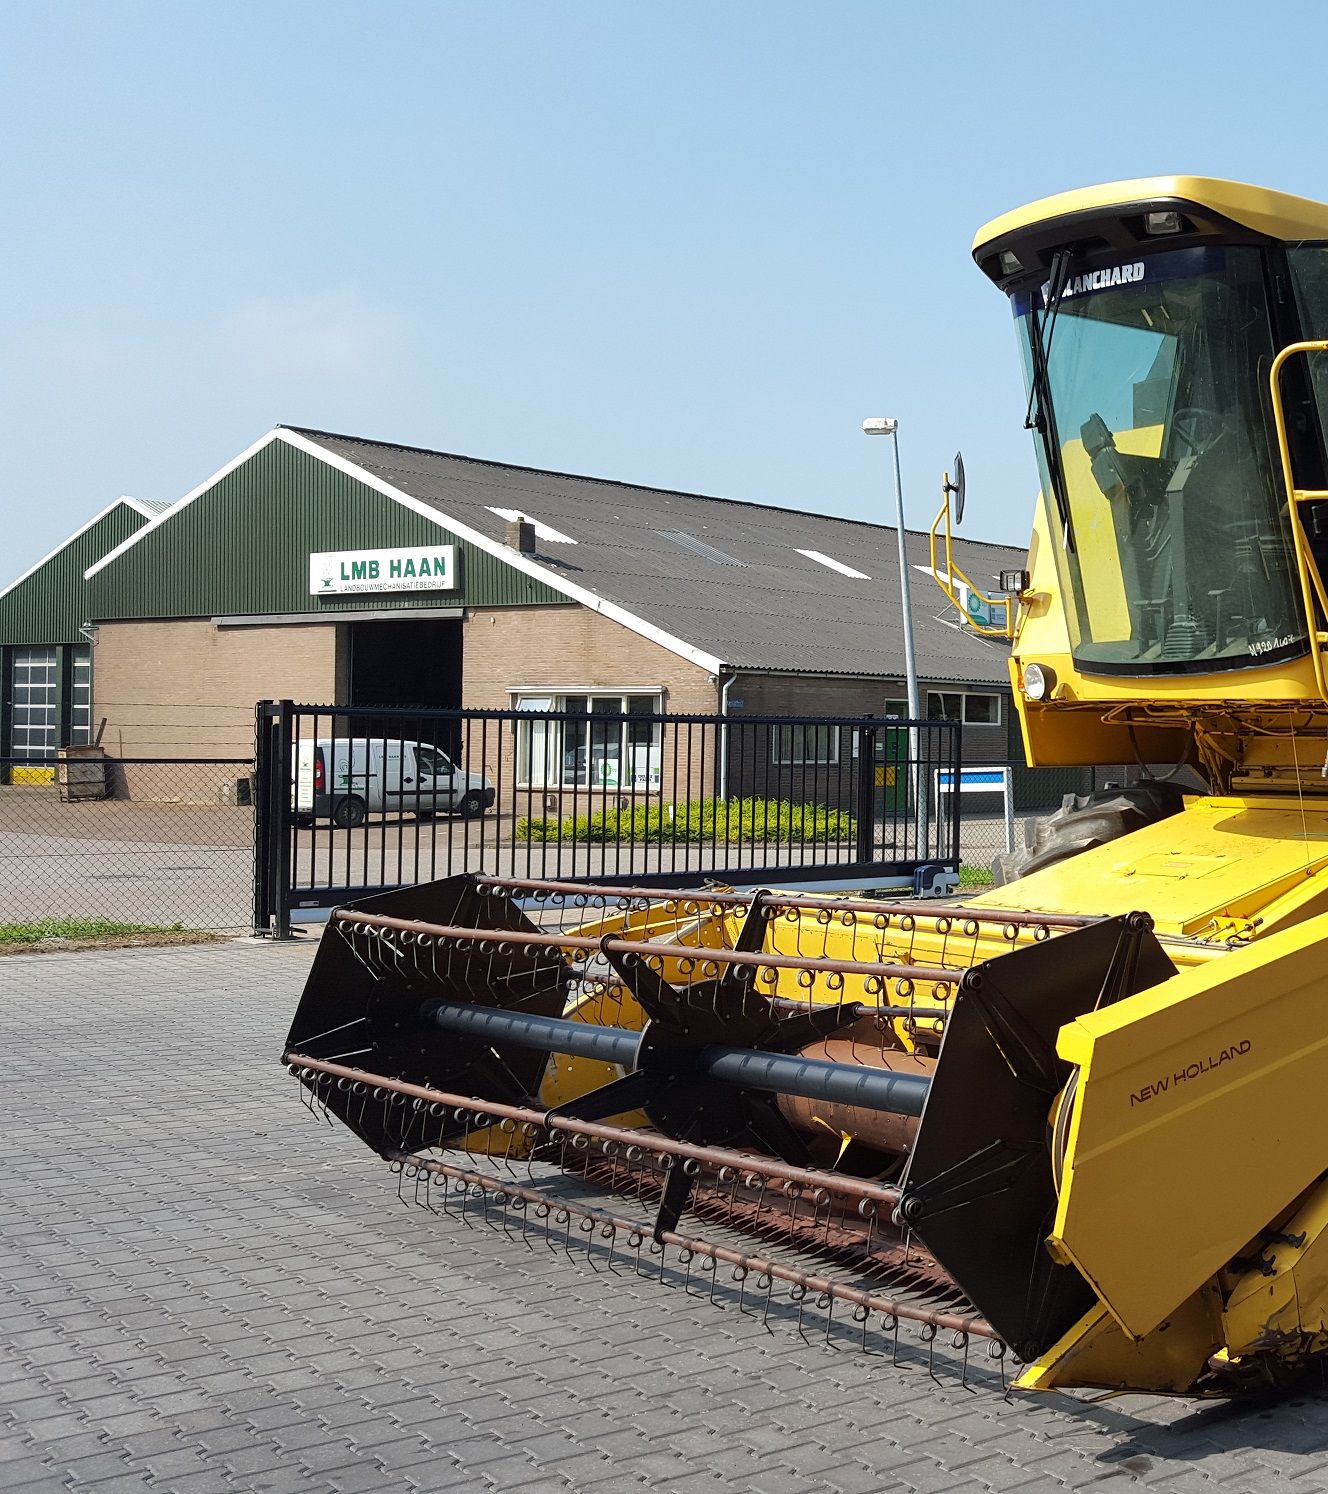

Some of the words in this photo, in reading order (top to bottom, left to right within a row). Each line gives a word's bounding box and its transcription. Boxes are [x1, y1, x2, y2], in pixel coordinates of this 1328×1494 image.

[340, 560, 380, 581] LMB
[389, 556, 446, 579] HAAN
[340, 581, 446, 593] LANDBOUWMECHANISATIEBEDRIJF
[1130, 1077, 1169, 1107] NEW
[1173, 1040, 1252, 1086] HOLLAND
